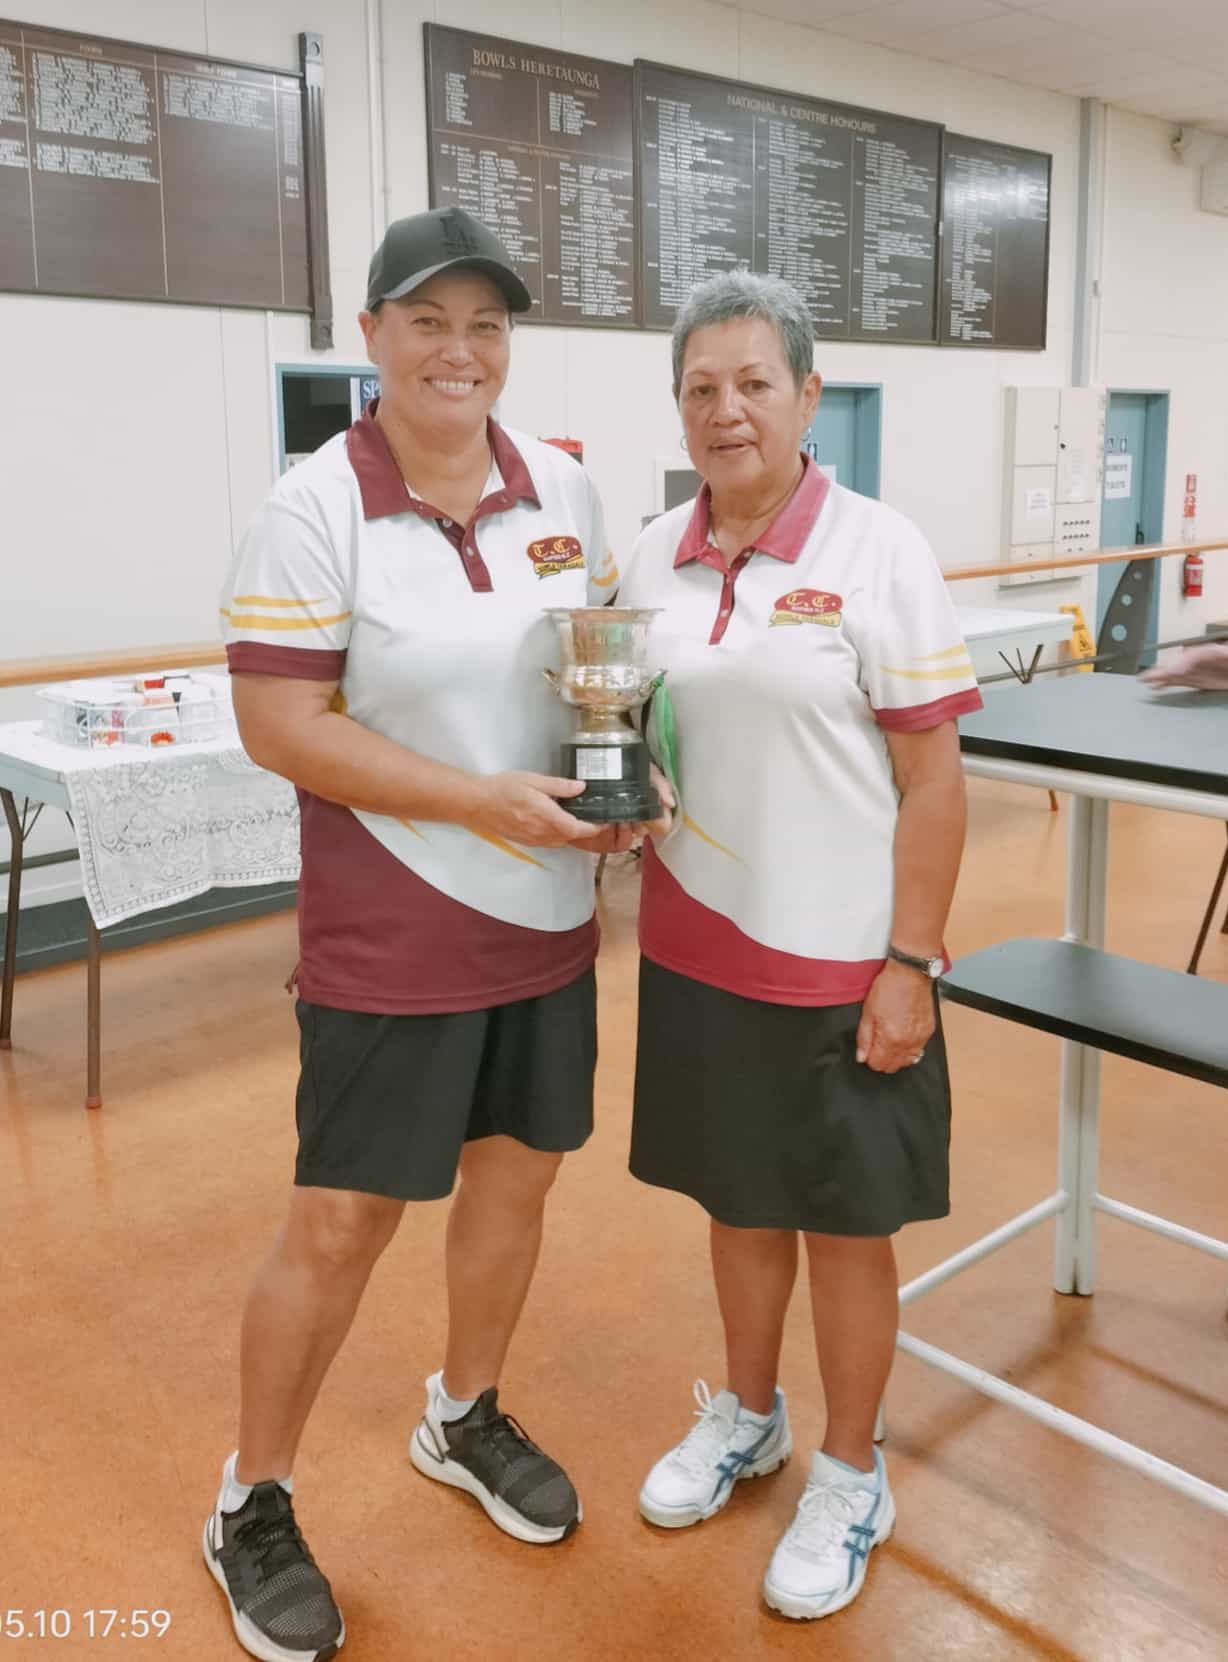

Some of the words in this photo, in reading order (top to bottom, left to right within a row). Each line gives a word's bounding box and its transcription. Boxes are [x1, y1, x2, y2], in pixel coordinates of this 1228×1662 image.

[472, 48, 516, 69] BOWLS
[520, 58, 600, 89] HERETAUNGA
[727, 95, 777, 114] NATIONAL
[790, 106, 829, 125] CENTRE
[830, 114, 877, 135] HONOURS
